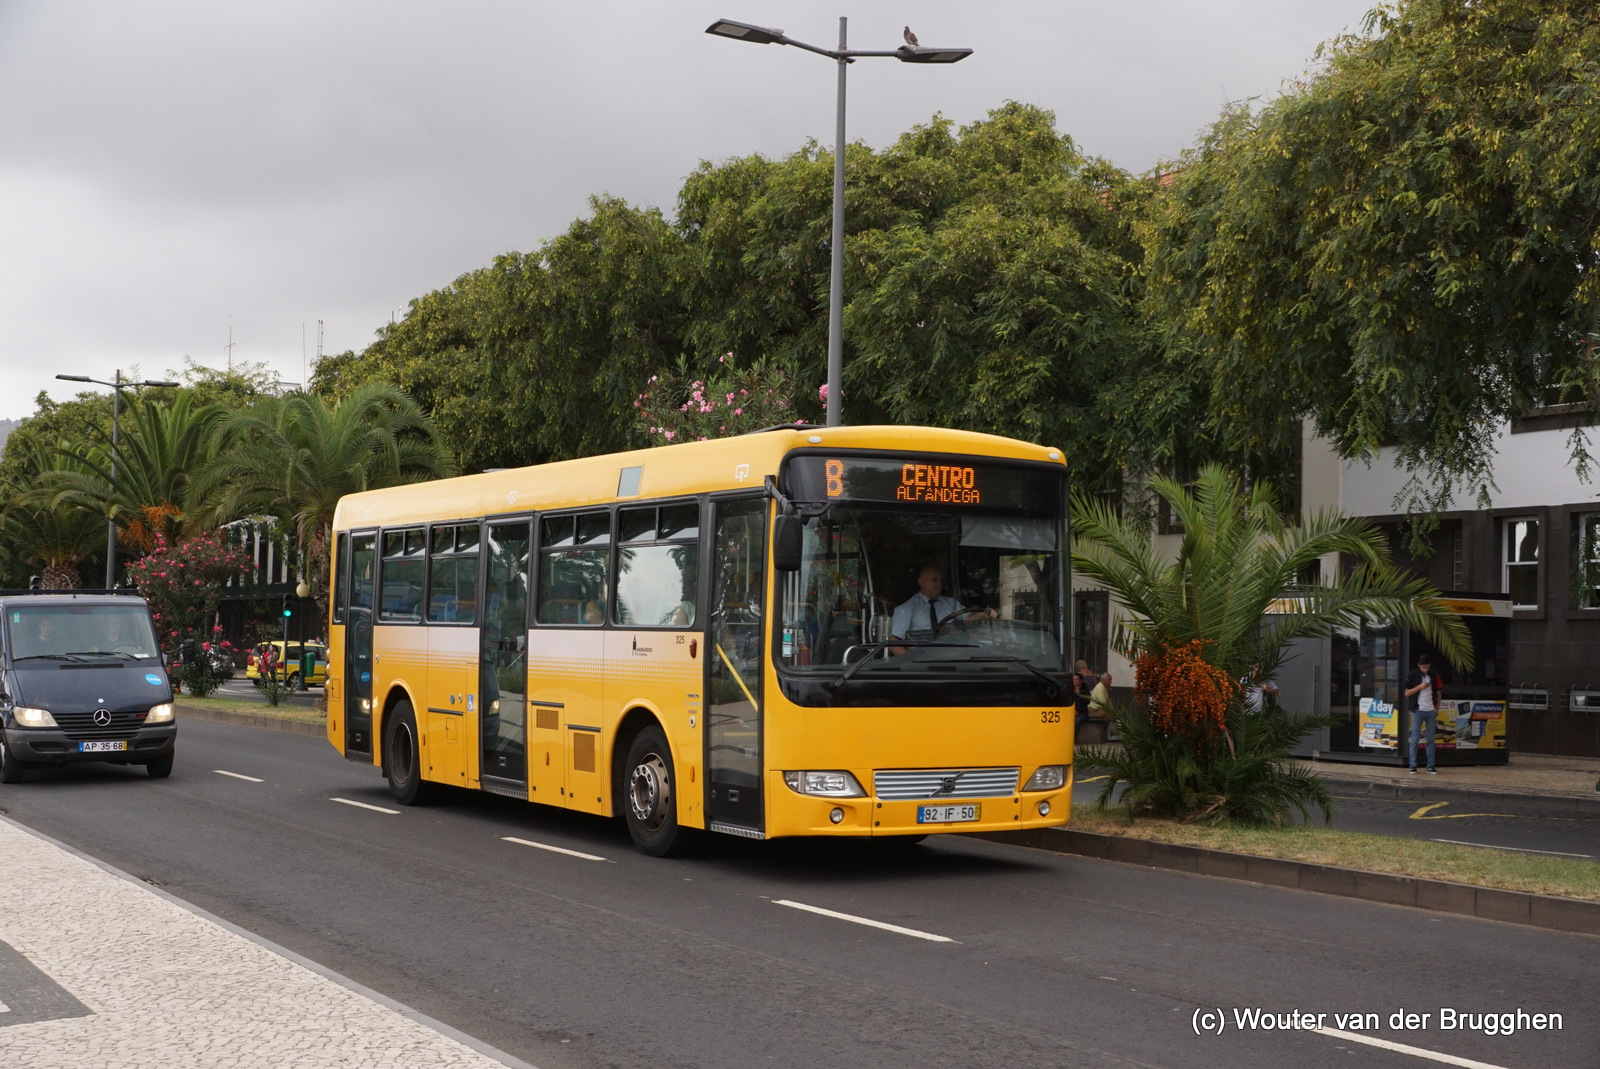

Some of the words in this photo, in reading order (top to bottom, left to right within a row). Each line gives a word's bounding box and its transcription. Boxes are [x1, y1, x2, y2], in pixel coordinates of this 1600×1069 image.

[825, 459, 844, 497] B
[902, 463, 975, 489] CENTRO
[676, 635, 685, 644] 325
[1041, 711, 1061, 724] 325
